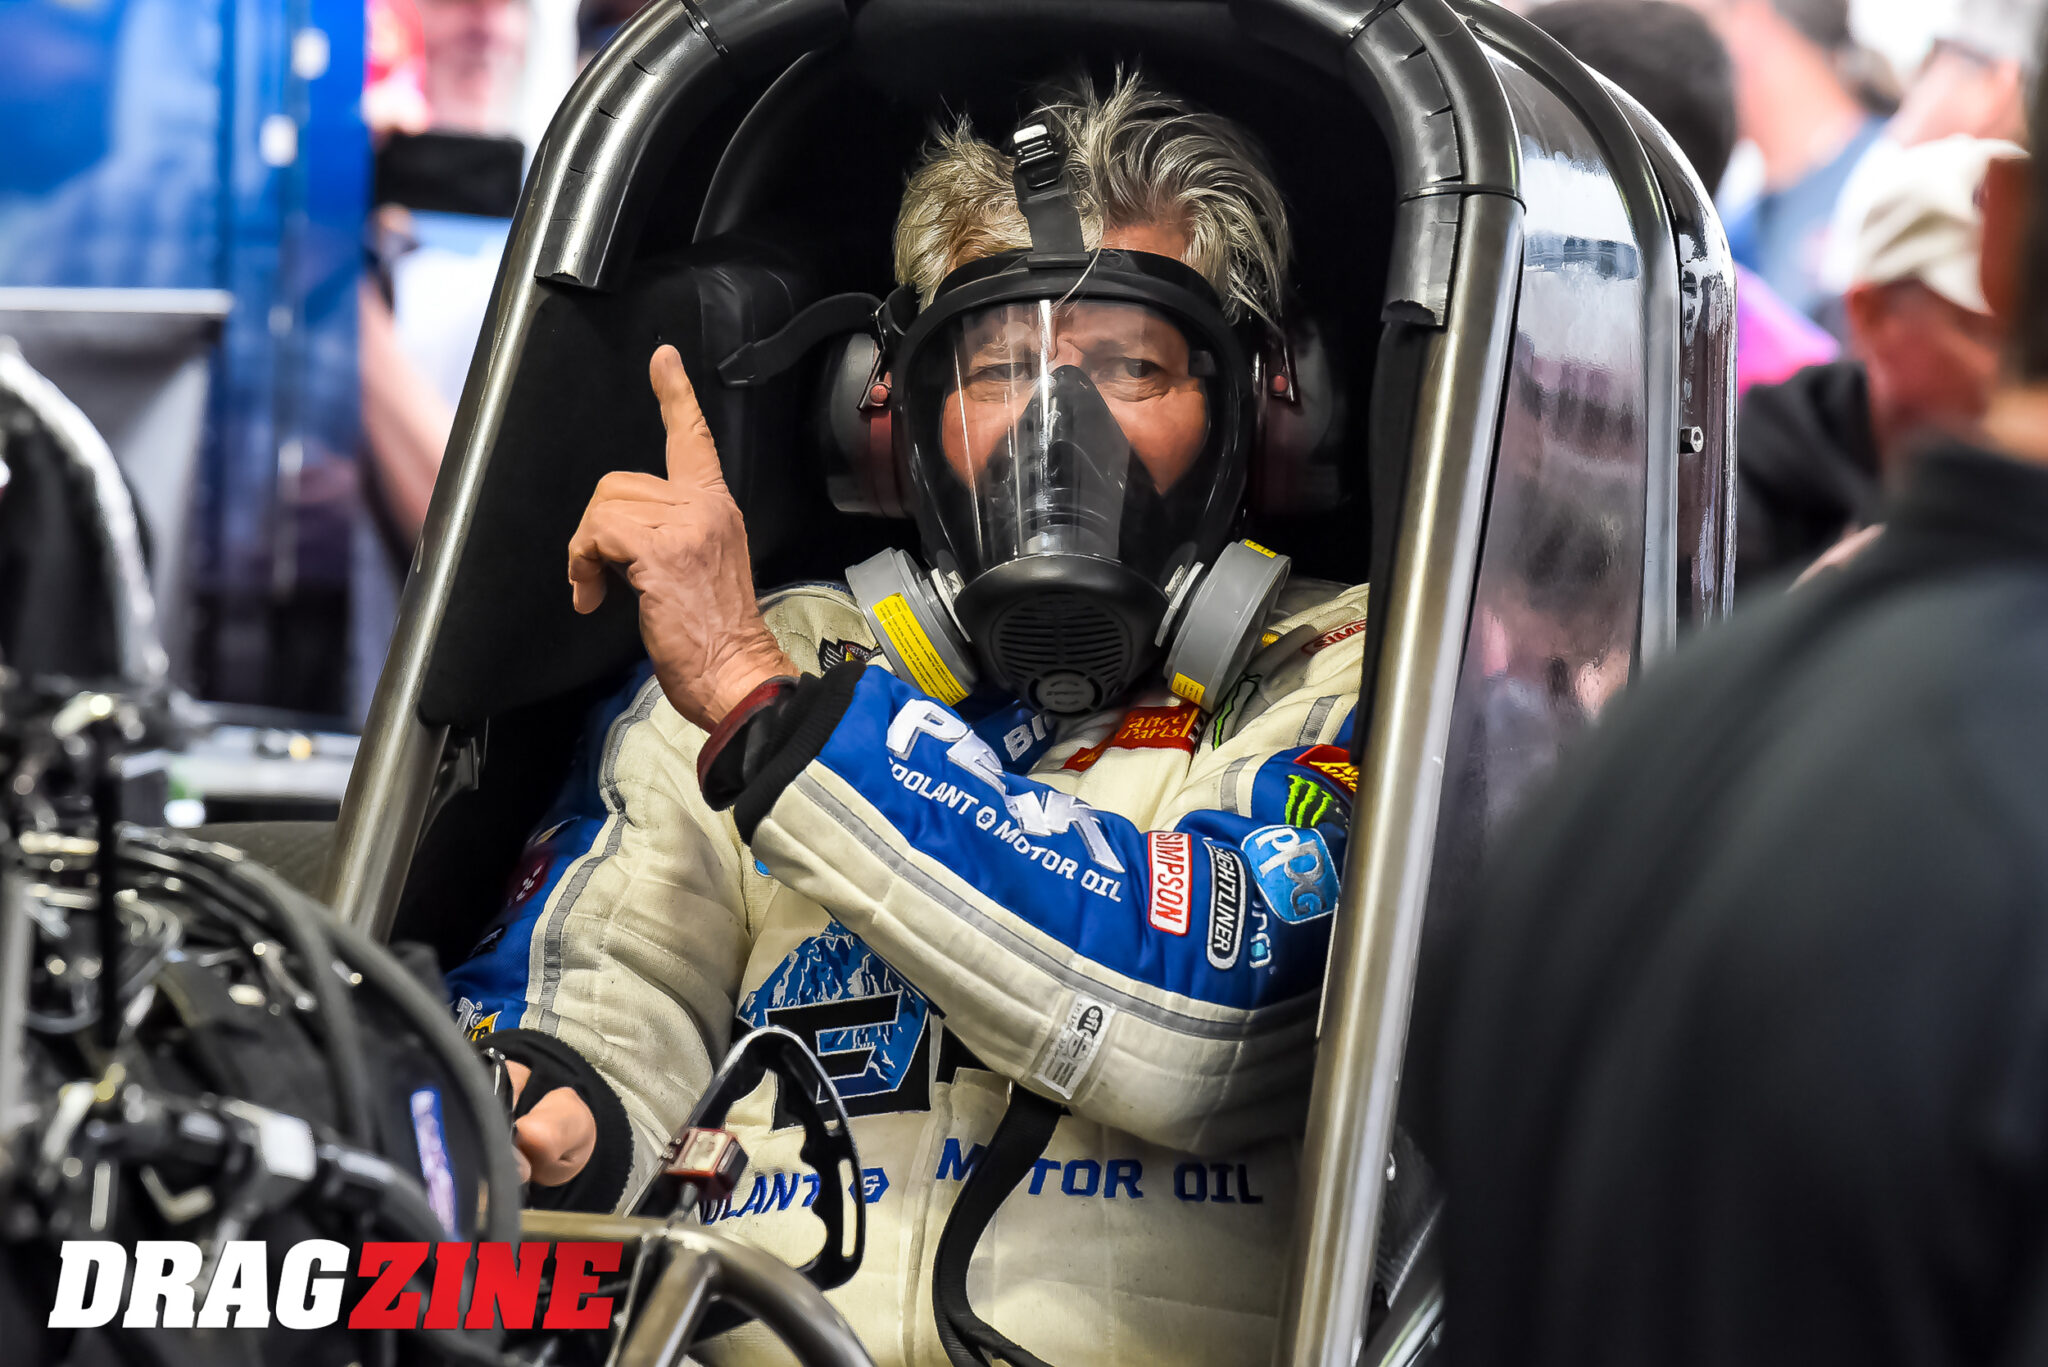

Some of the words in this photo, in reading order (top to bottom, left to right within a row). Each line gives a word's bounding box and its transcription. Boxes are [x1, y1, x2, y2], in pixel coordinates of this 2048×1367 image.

[888, 757, 979, 815] OOLANT
[993, 819, 1079, 880] MOTOR
[1081, 868, 1122, 903] OIL
[1155, 832, 1185, 924] SIMPSON
[936, 1137, 1144, 1199] MTOR
[1173, 1161, 1264, 1205] OIL
